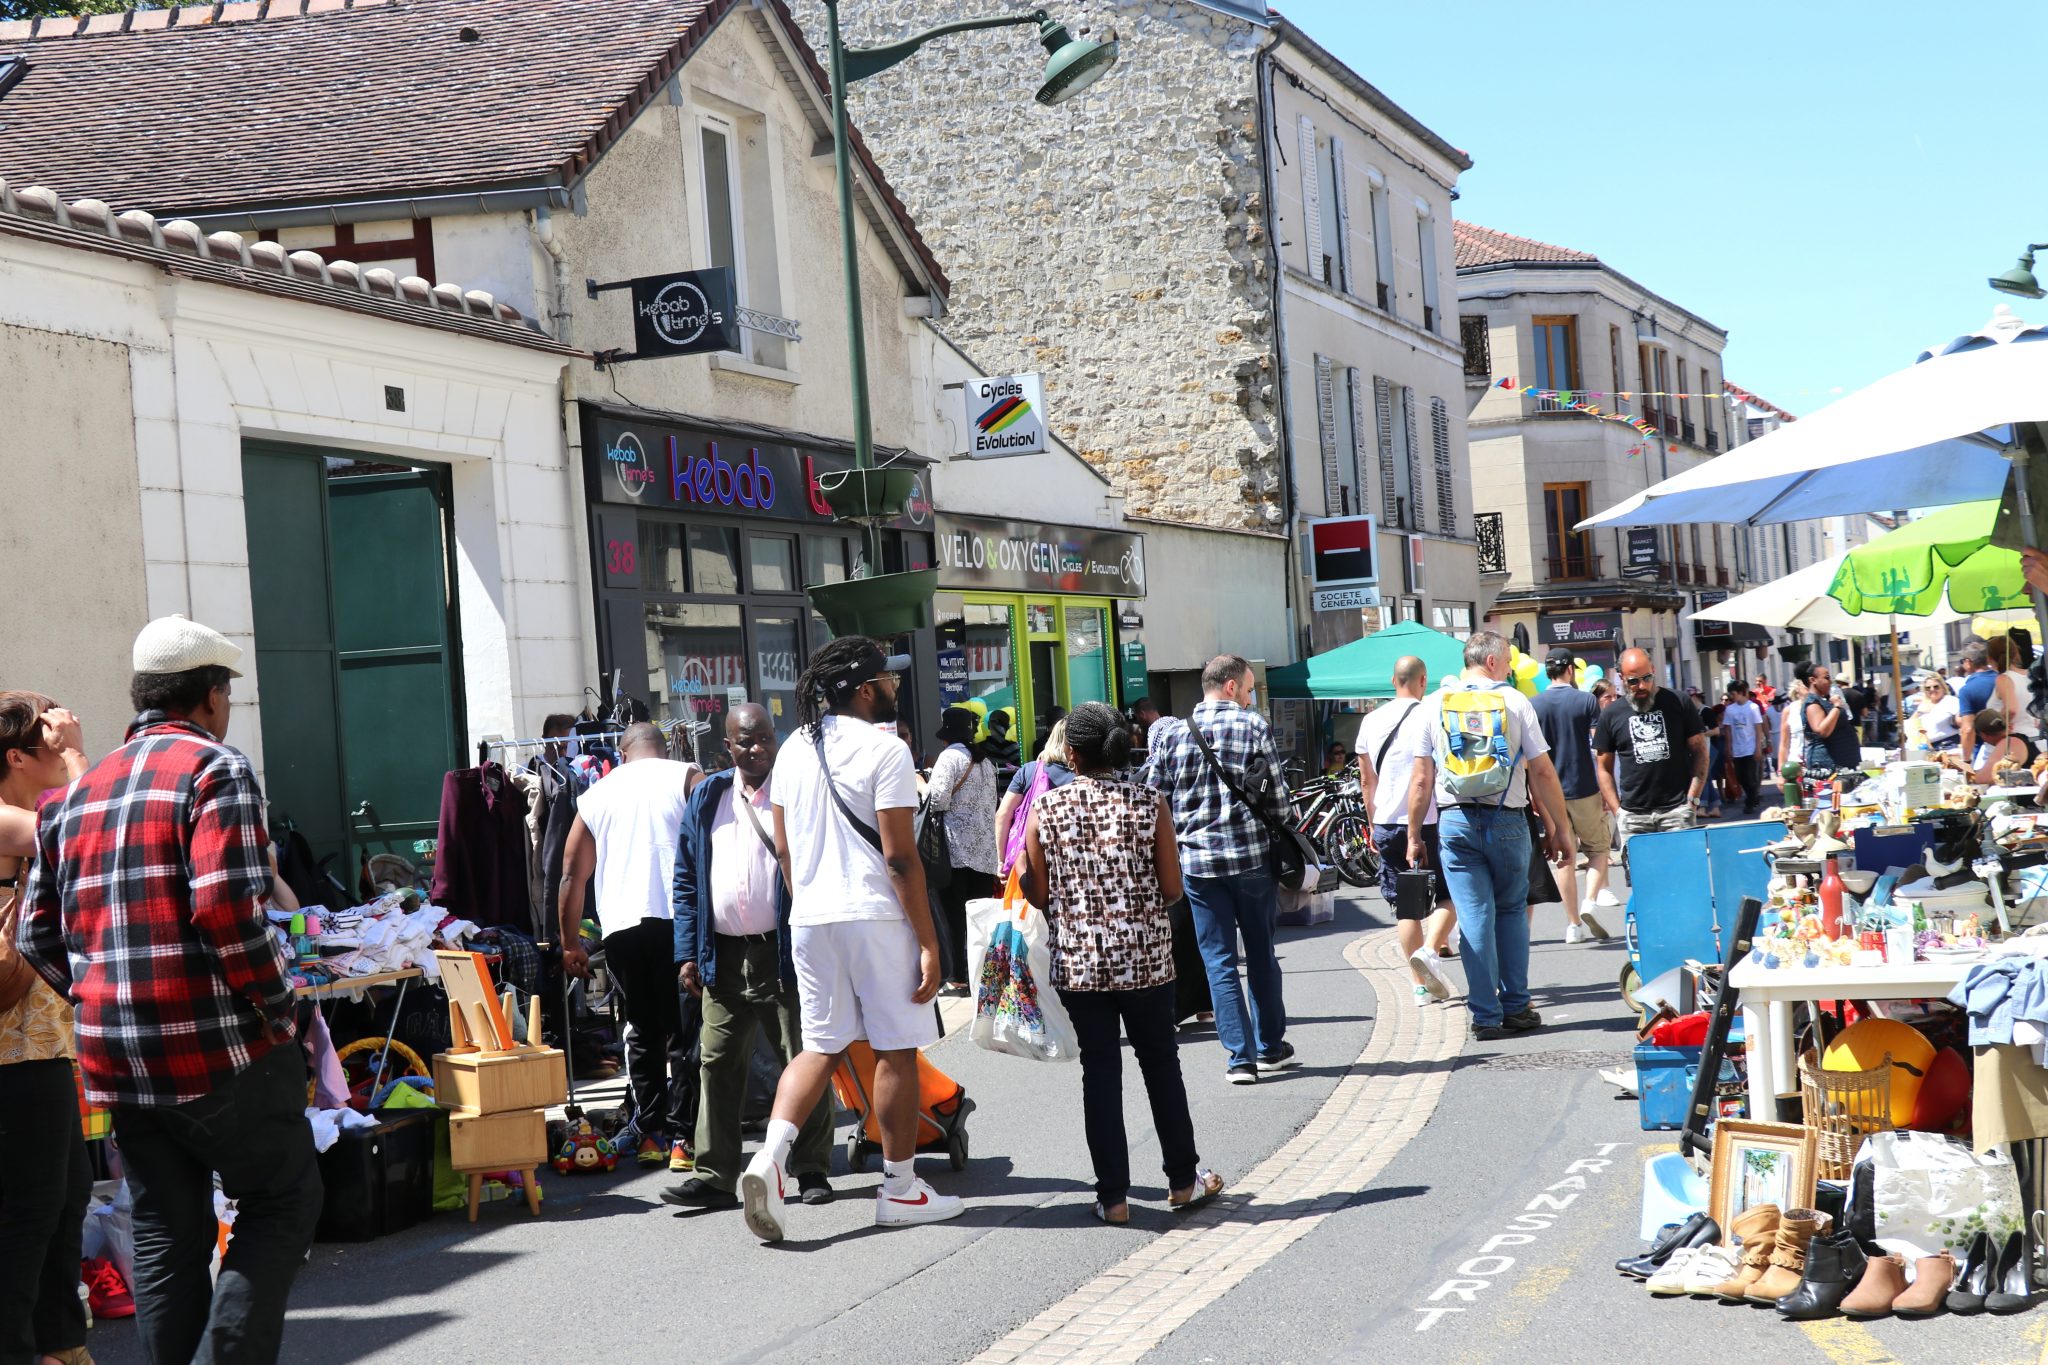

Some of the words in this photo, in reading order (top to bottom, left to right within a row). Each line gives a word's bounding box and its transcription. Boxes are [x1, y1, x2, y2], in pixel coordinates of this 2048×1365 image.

[639, 296, 690, 317] kebab
[981, 381, 1023, 403] Cycles
[606, 443, 636, 462] kebab
[666, 435, 775, 509] kebab
[607, 539, 635, 574] 38
[941, 534, 984, 569] VELO
[999, 540, 1060, 574] OXYGEN
[1320, 591, 1361, 601] SOCIETE
[1320, 598, 1372, 609] GENERALE
[1573, 630, 1606, 639] MARKET
[671, 675, 702, 693] kebab
[1415, 1142, 1633, 1332] TRANSPORT
